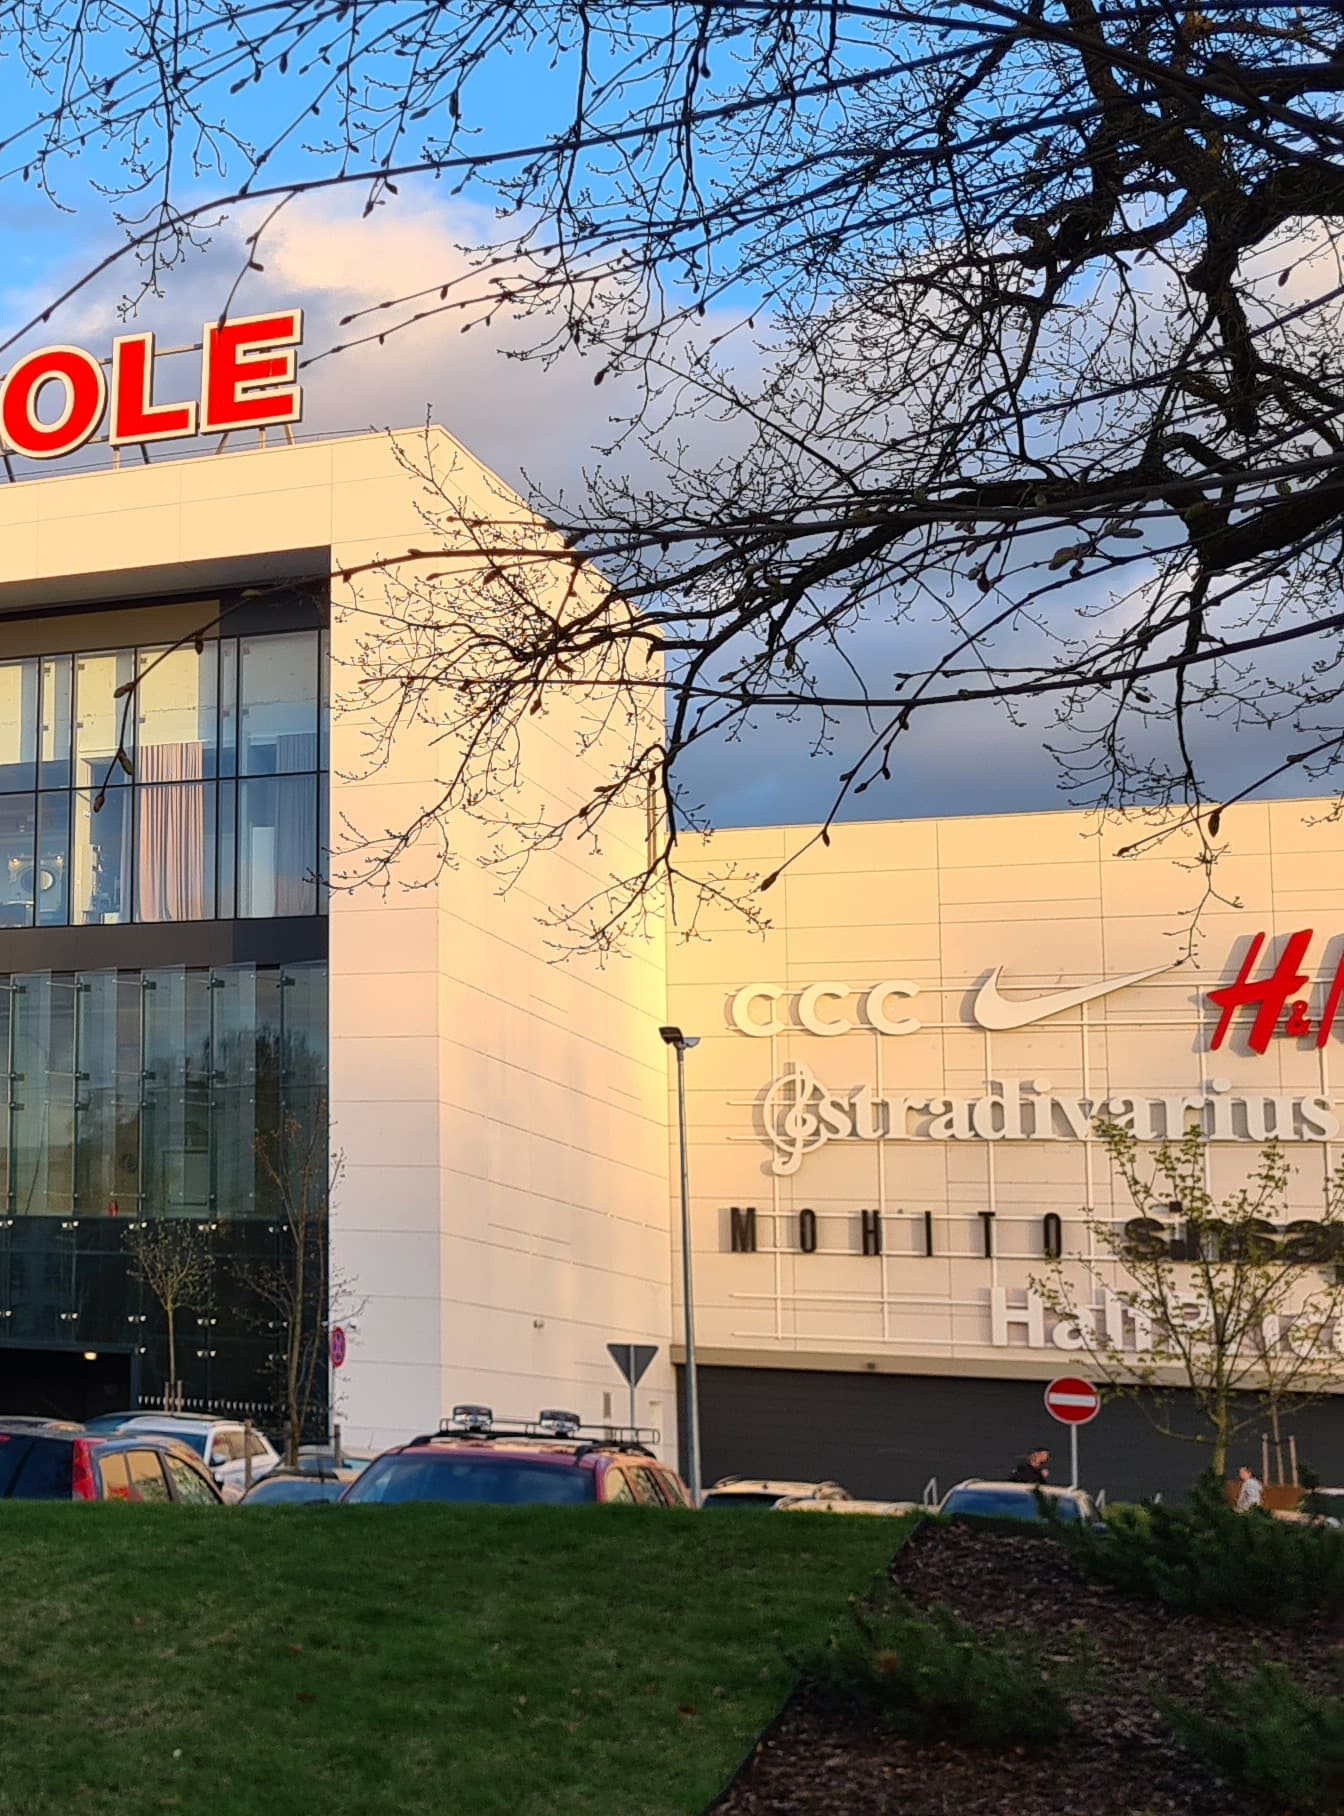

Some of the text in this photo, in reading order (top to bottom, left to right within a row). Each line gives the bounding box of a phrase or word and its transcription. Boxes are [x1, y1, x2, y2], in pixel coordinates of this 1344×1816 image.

[732, 980, 922, 1037] CCC
[1206, 928, 1344, 1055] H&
[730, 1207, 1062, 1259] MOHITO
